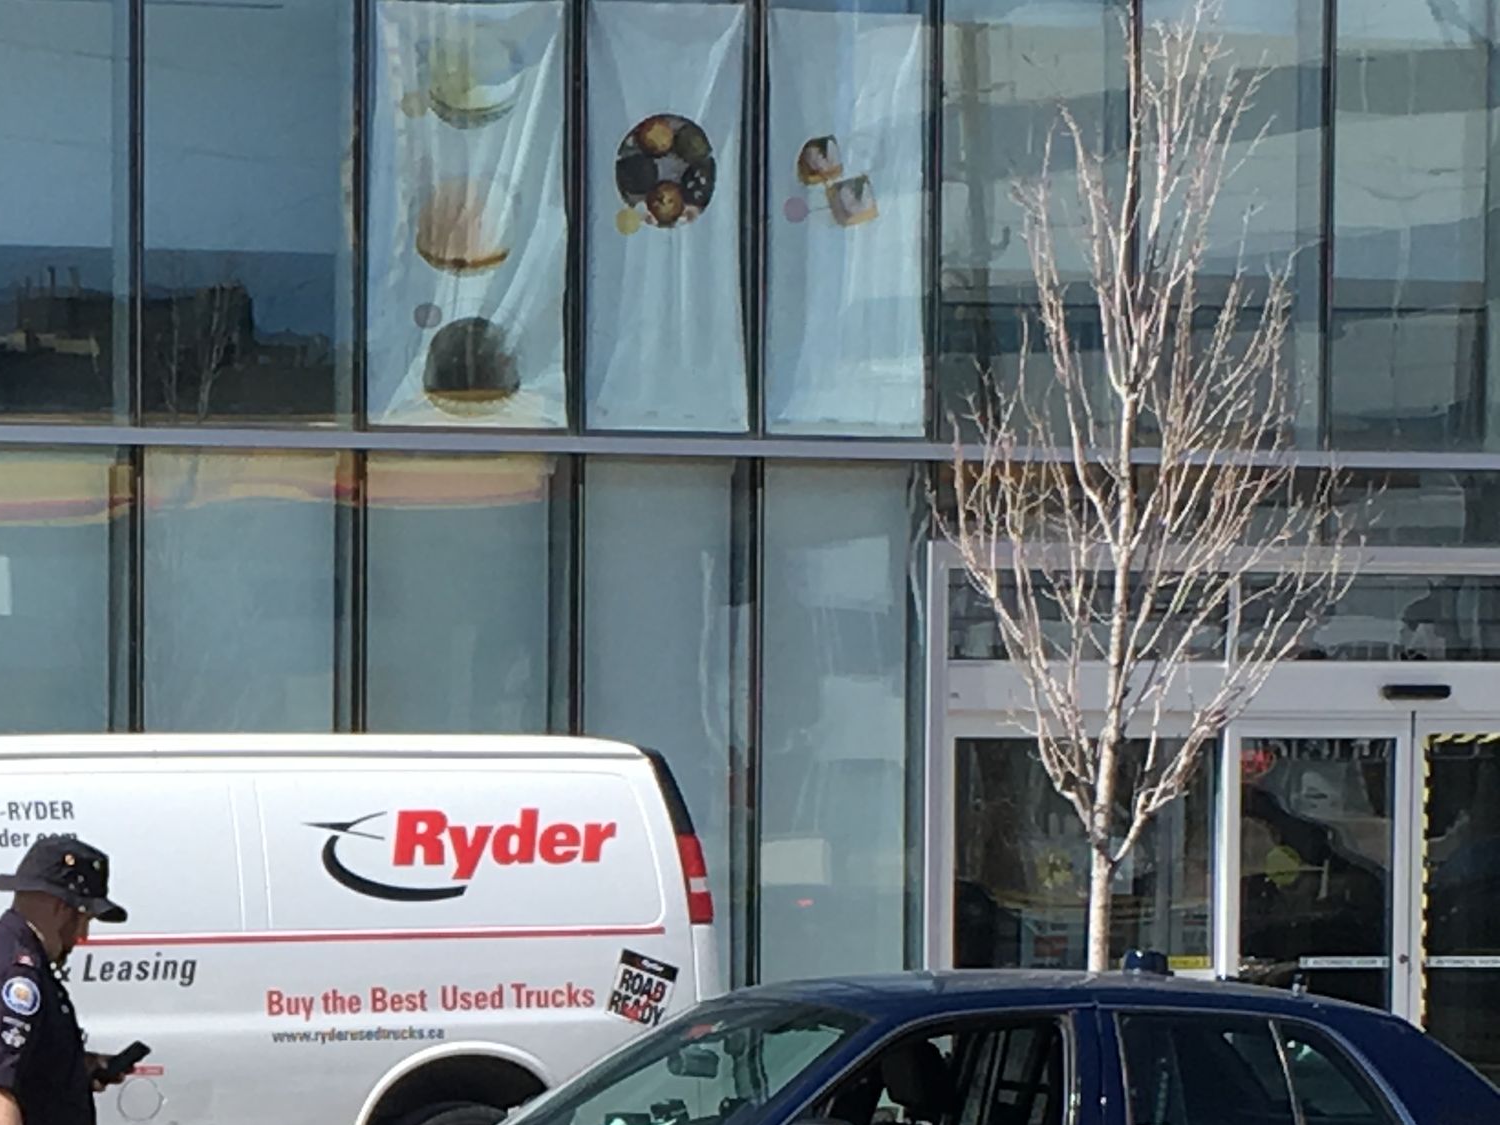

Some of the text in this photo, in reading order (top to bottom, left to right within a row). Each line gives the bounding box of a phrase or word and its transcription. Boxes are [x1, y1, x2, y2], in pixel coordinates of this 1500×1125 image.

[392, 808, 618, 880] Ryder
[83, 953, 197, 987] Leasing
[619, 968, 666, 1003] ROAD
[267, 982, 596, 1021] Buy the Best Used Trucks
[607, 990, 666, 1028] READY
